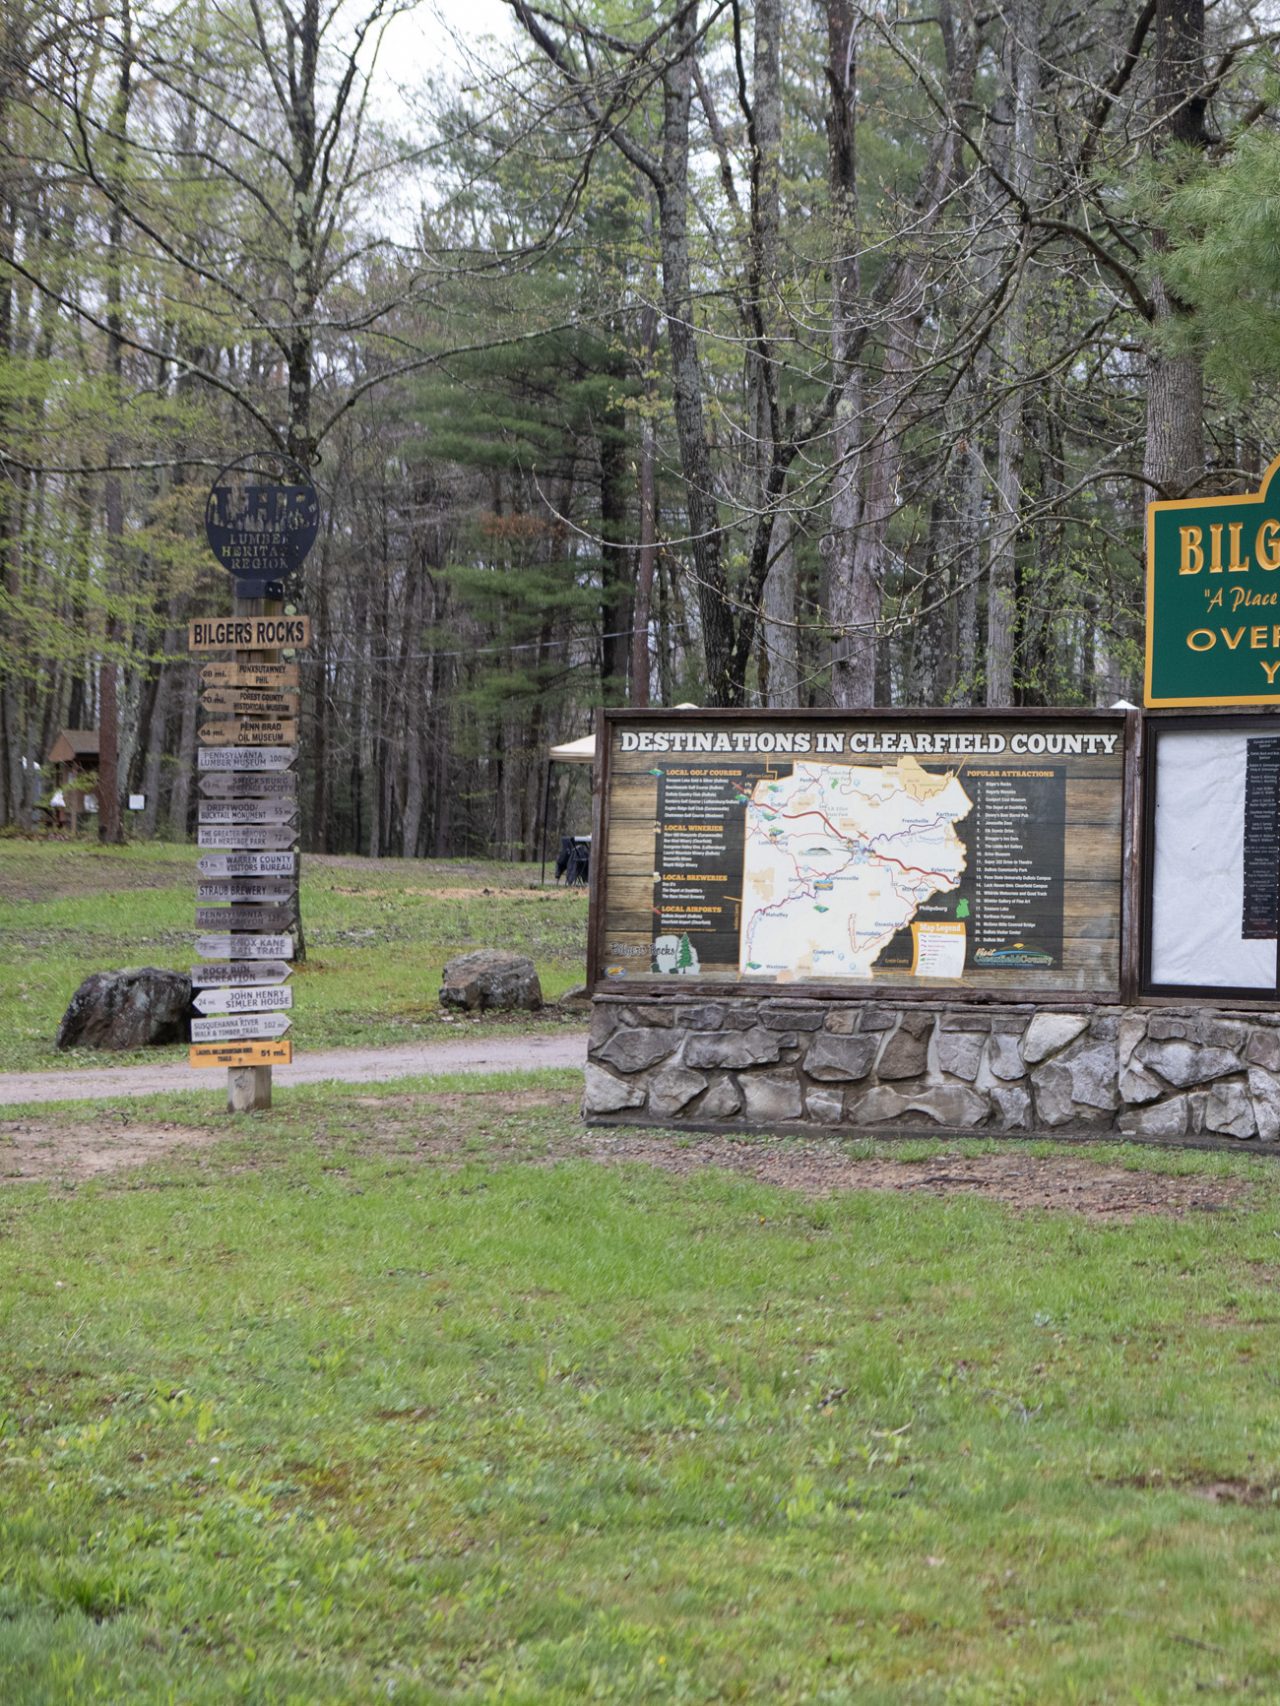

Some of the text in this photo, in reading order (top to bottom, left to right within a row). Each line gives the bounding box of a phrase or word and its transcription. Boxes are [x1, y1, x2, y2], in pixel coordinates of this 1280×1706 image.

[1229, 586, 1278, 613] Place
[194, 621, 304, 644] BILGERS ROCKS
[621, 732, 1118, 753] DESTINATIONS IN CLEARFIELD COUNTY
[231, 886, 266, 895] BREWERY
[935, 924, 960, 932] Legend
[202, 967, 228, 975] ROCK
[197, 974, 256, 983] RECREATION
[231, 992, 253, 1000] JOHN
[226, 999, 258, 1008] SIMLER
[261, 998, 289, 1006] HOUSE
[194, 1018, 258, 1030] SUSQUEHANNA RIVER
[194, 1030, 210, 1038] WALK
